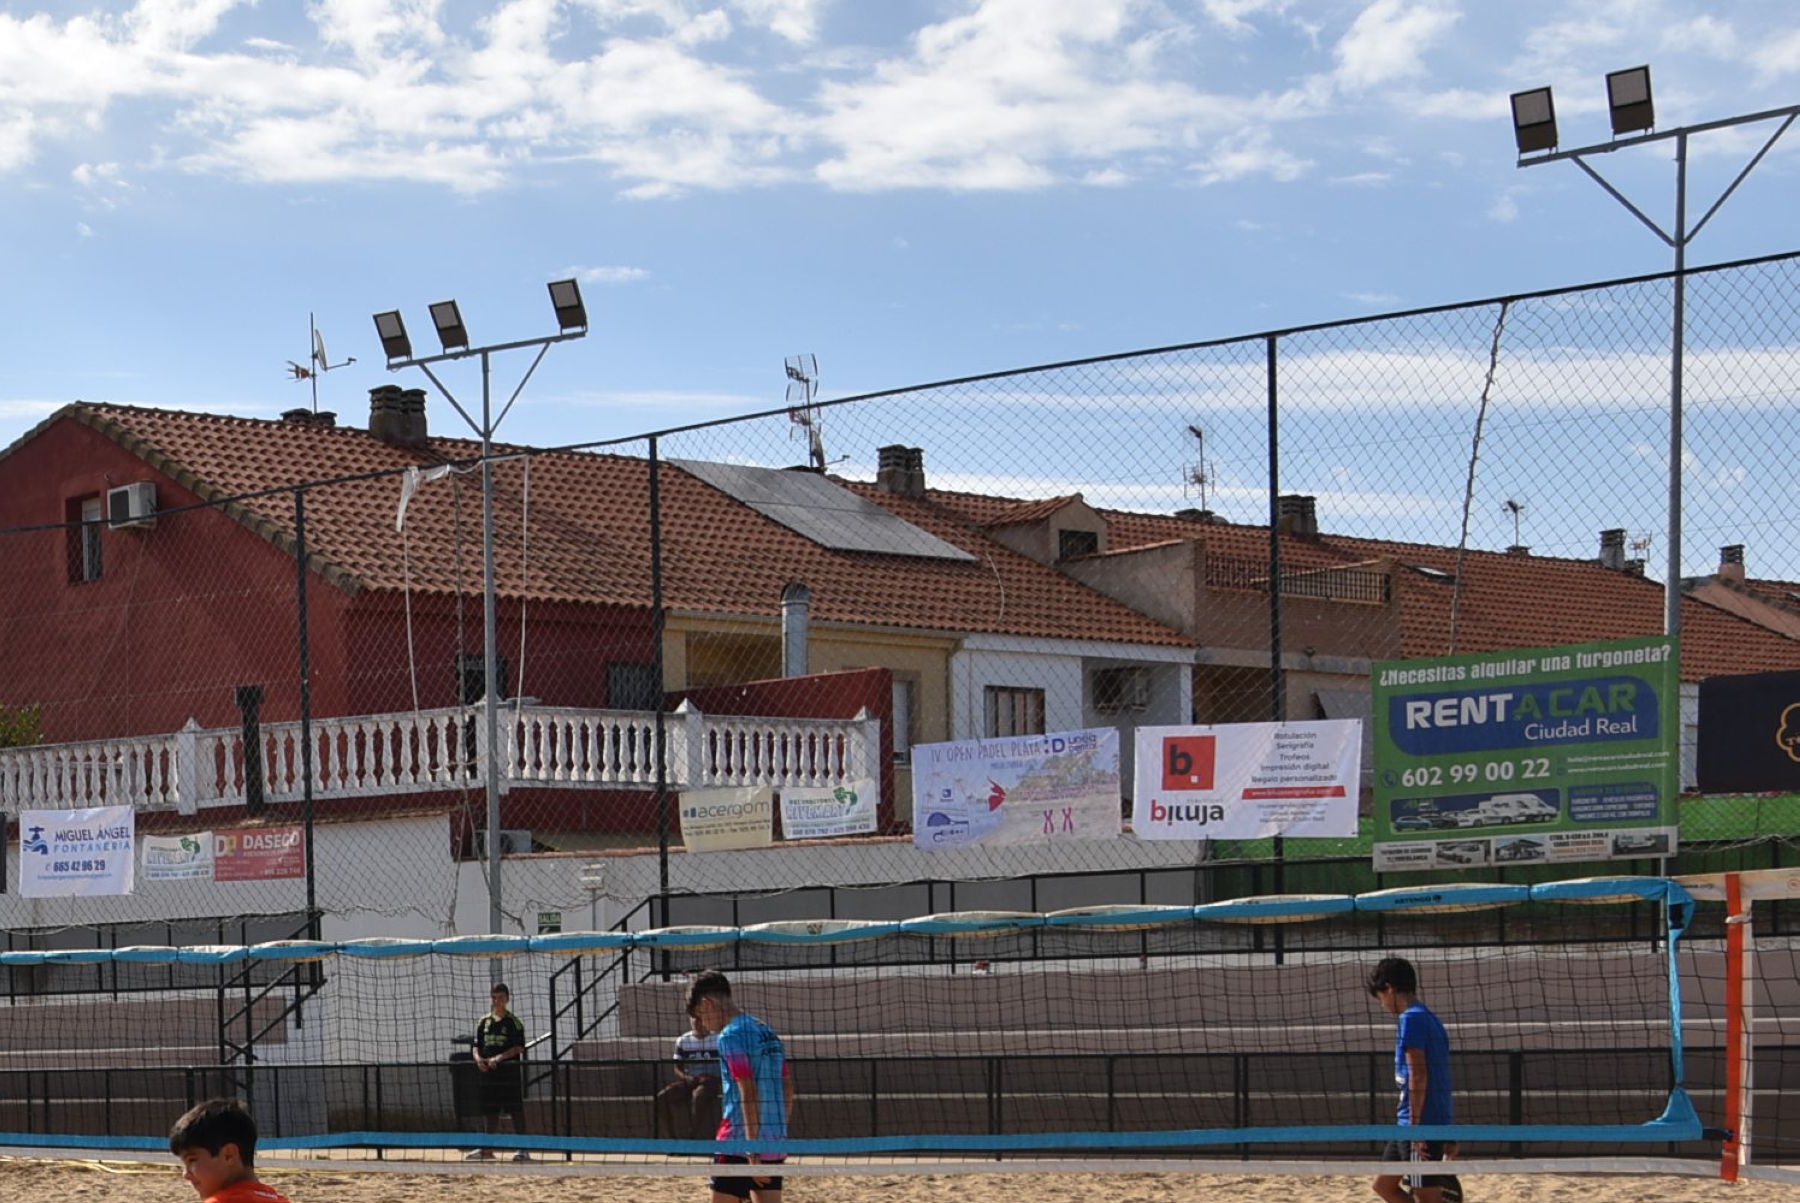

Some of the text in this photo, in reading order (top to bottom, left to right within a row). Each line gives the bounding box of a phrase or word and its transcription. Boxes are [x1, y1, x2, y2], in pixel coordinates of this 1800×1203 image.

[1380, 644, 1672, 687] ¿Necesitas alquilar una furgoneta?
[1406, 693, 1513, 730] RENT
[1548, 683, 1638, 718] CAR
[1524, 714, 1638, 740] Ciudad Real
[1402, 758, 1550, 787] 602 99 00 22
[55, 828, 94, 842] MIGUEL
[242, 831, 300, 850] DASEGO
